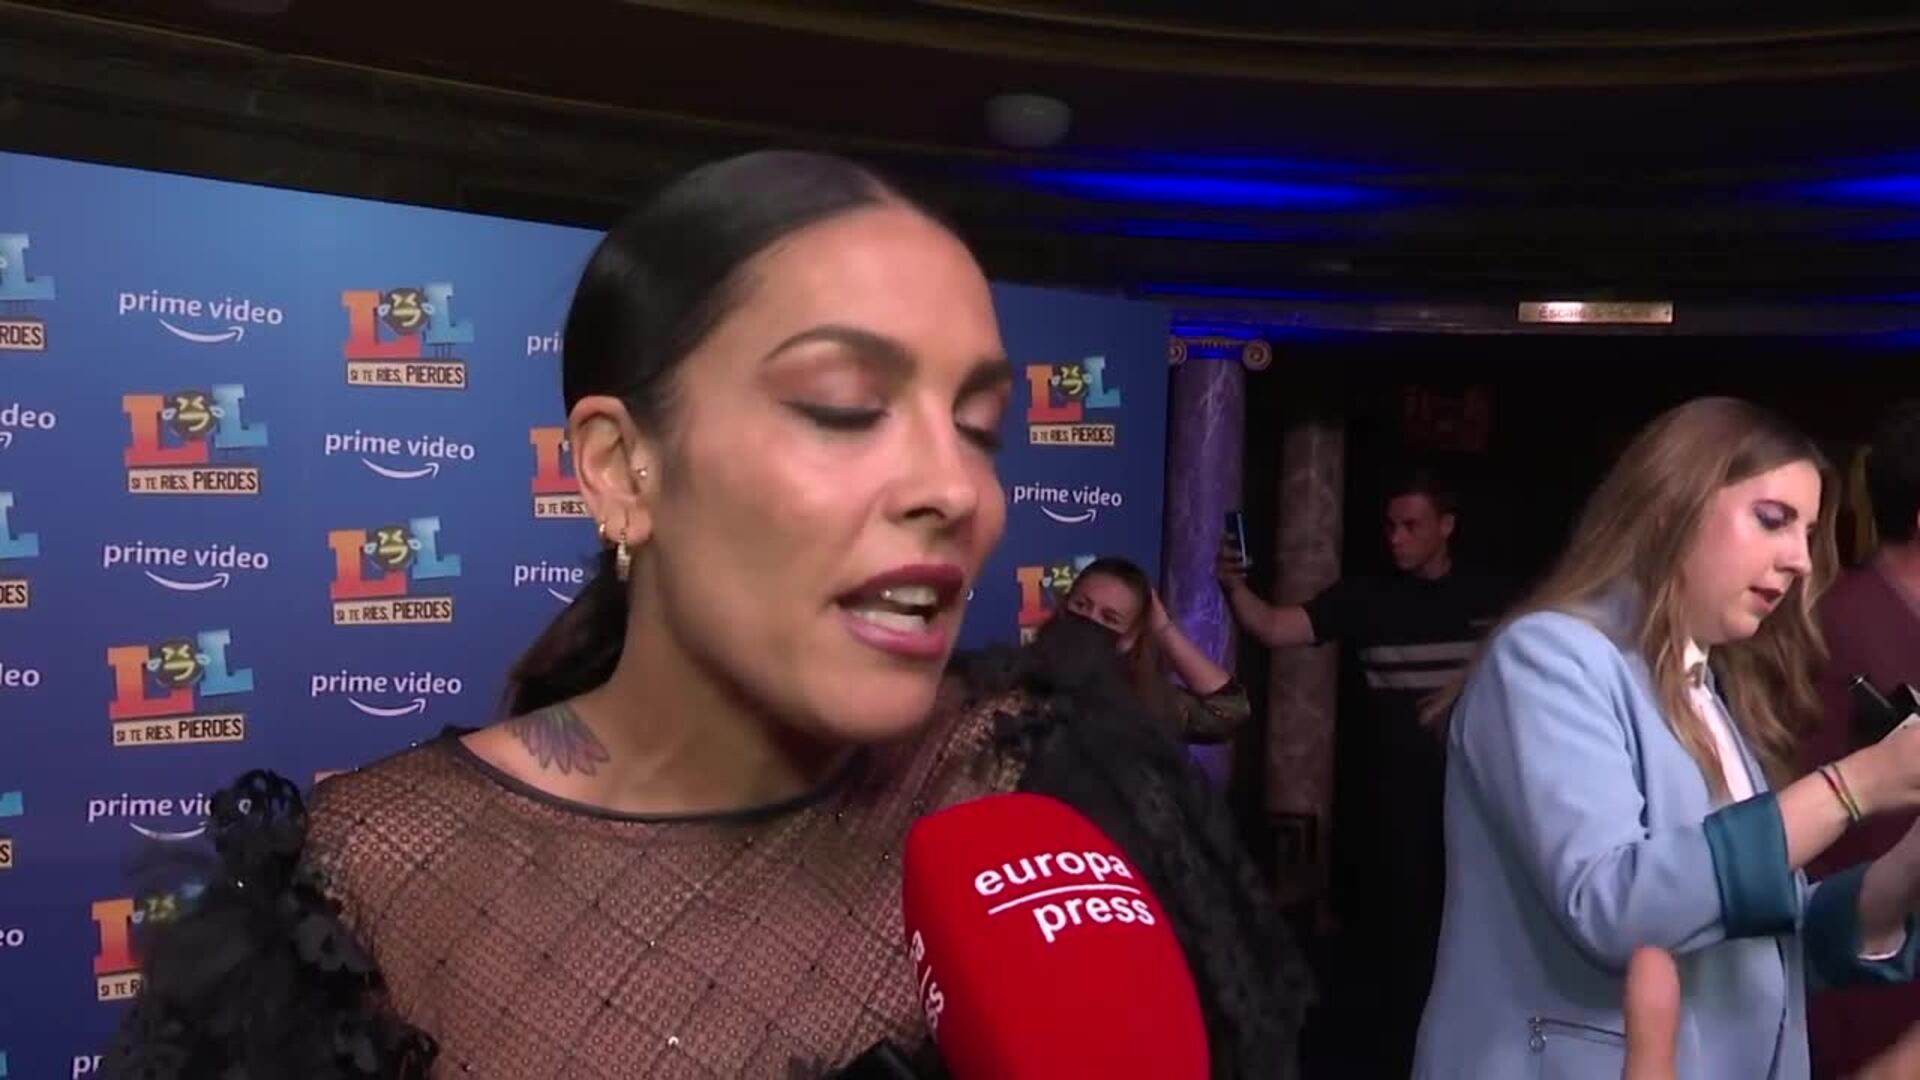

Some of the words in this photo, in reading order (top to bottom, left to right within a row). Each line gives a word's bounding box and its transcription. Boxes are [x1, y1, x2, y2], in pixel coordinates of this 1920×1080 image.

[119, 289, 201, 317] prime
[209, 297, 283, 325] video
[527, 332, 564, 356] pri
[406, 365, 464, 385] PIERDES
[325, 430, 400, 455] prime
[407, 436, 475, 460] video
[1072, 426, 1113, 443] PIERDES
[193, 471, 257, 490] PIERDES
[1014, 482, 1068, 503] prime
[1072, 486, 1122, 507] video
[103, 540, 187, 567] prime
[194, 544, 269, 569] video
[514, 561, 584, 586] prime
[392, 600, 451, 620] PIERDES
[311, 670, 387, 696] prime
[394, 672, 462, 695] video
[178, 717, 242, 739] PIERDES
[88, 793, 172, 822] prime
[974, 851, 1133, 896] europa
[1033, 896, 1155, 943] press
